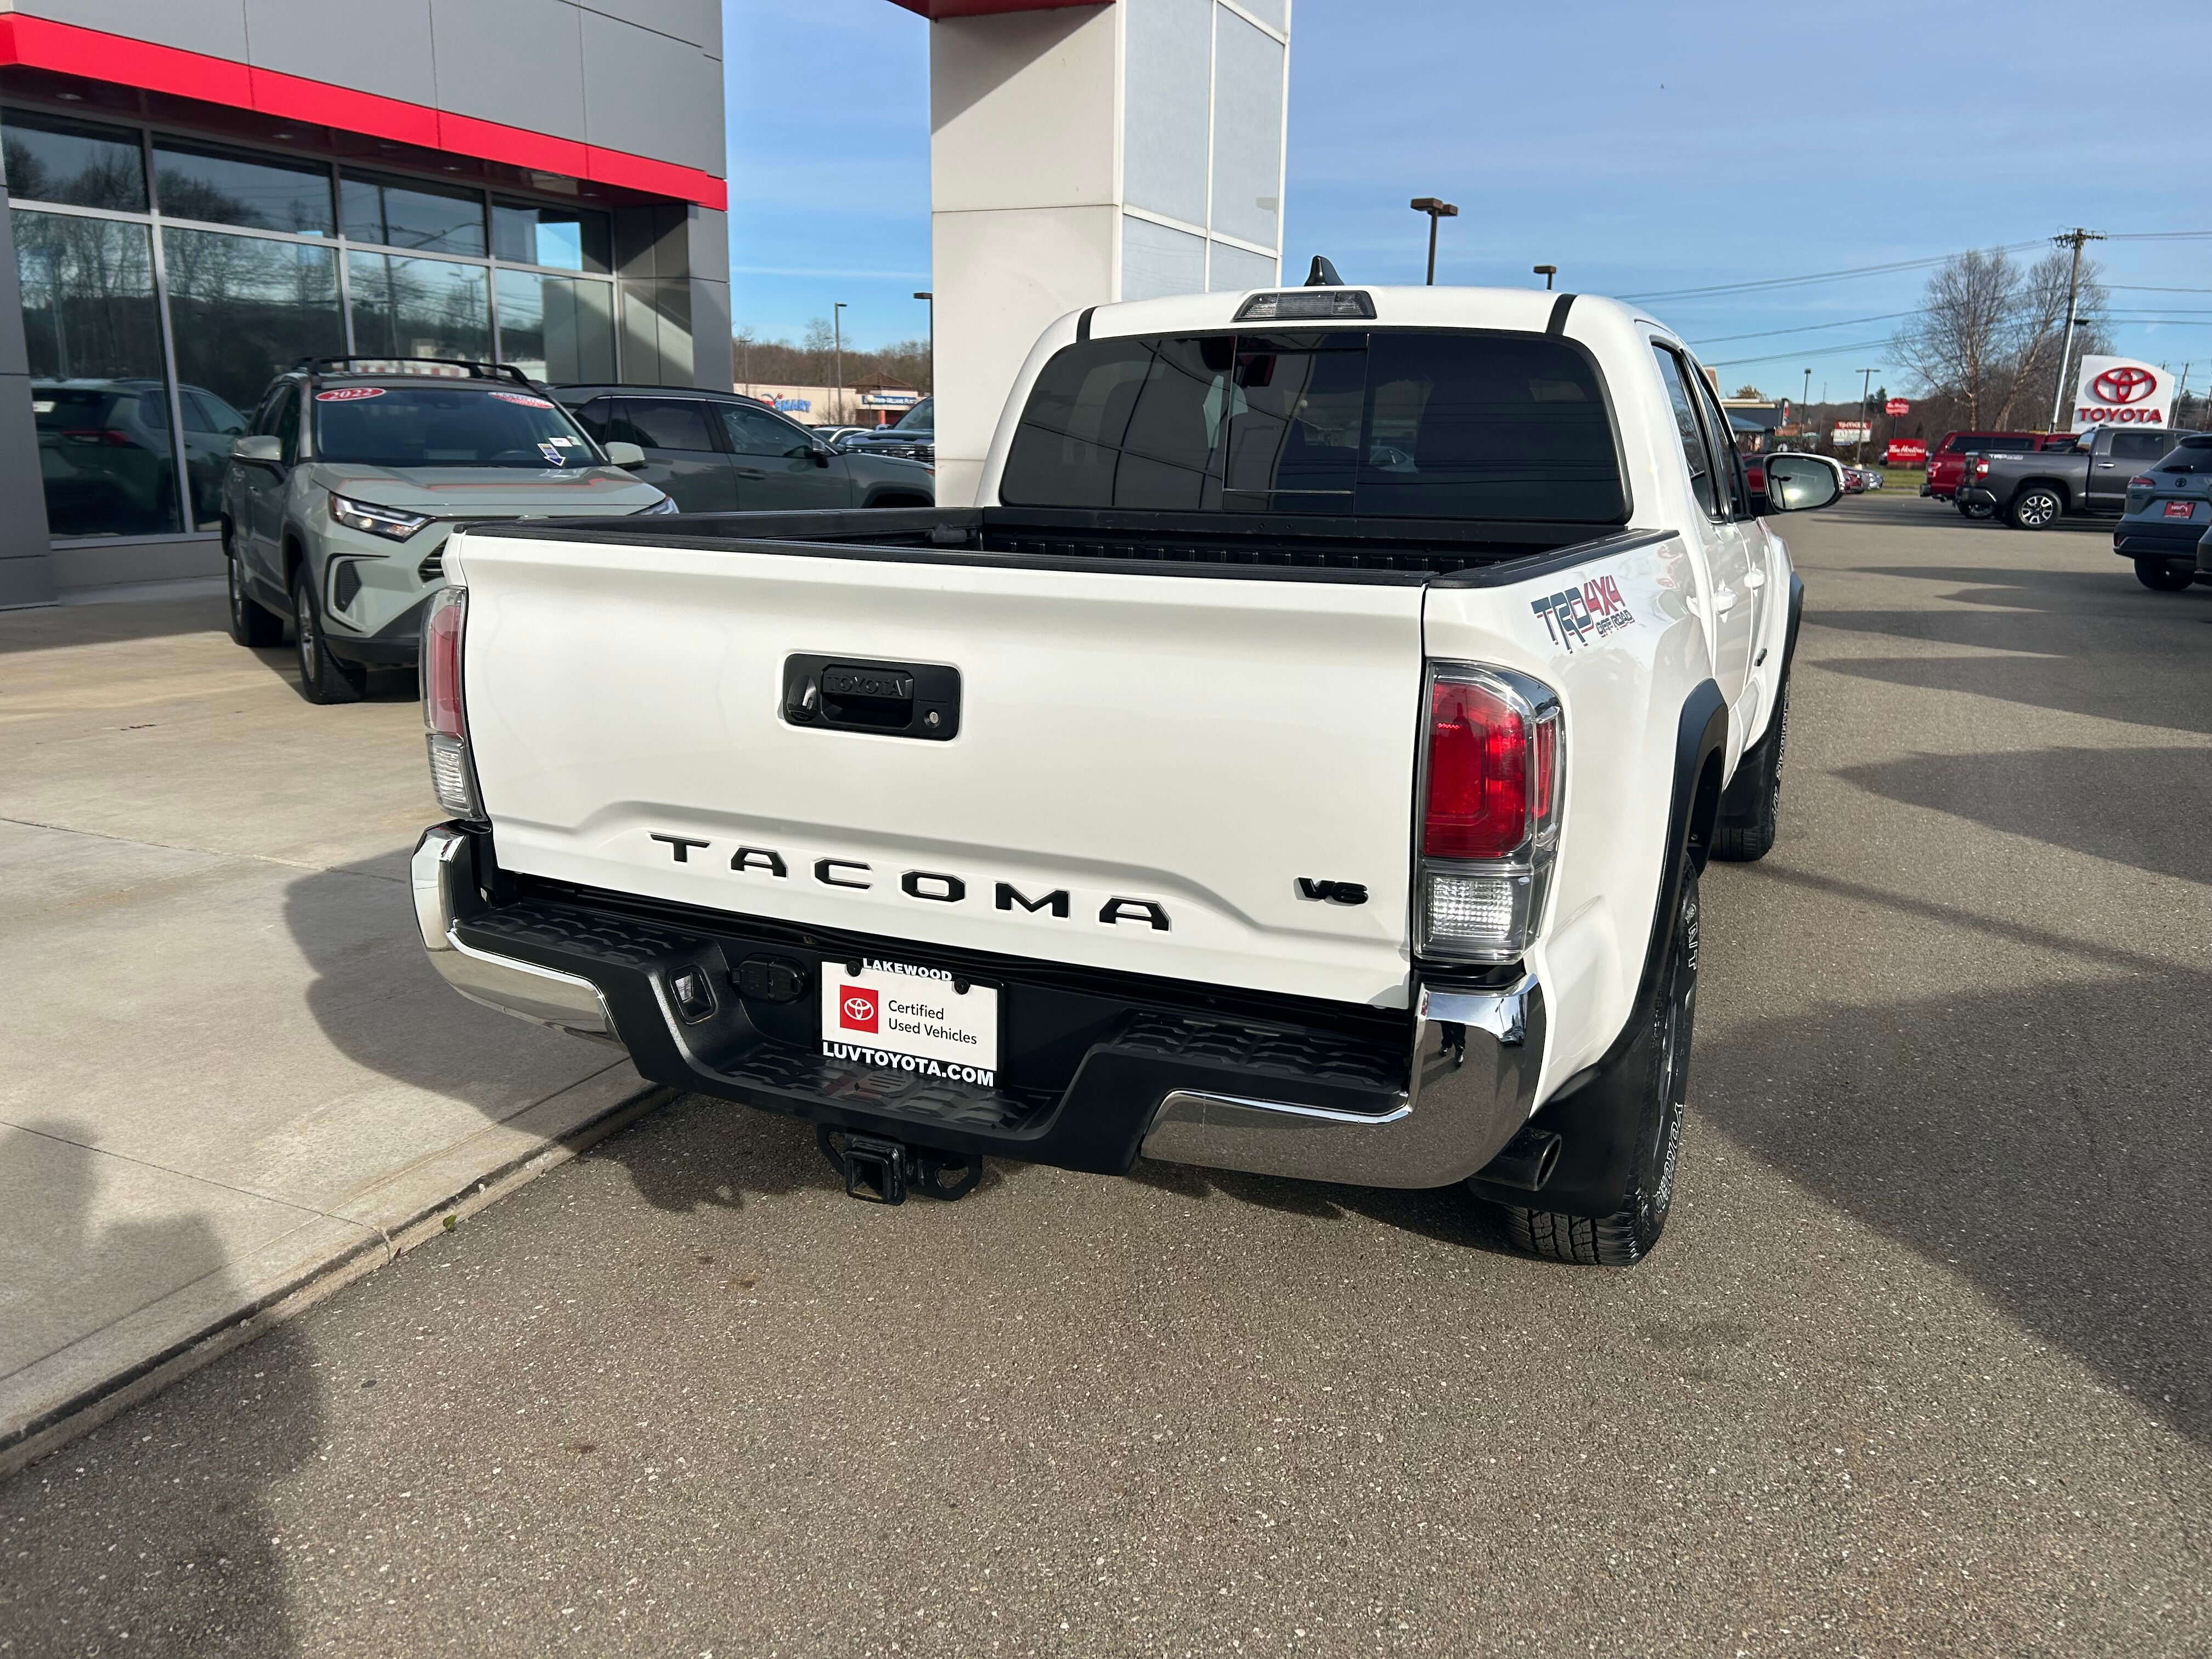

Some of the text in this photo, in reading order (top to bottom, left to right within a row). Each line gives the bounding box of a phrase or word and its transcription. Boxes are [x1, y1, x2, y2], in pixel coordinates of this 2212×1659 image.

[329, 388, 372, 399] 2022
[2078, 407, 2162, 422] TOYOTA
[1531, 587, 1594, 654] TRD
[1595, 610, 1635, 637] OFF ROAD
[827, 674, 904, 697] TOYOTA
[650, 833, 1172, 933] TACOMA
[1297, 877, 1368, 905] V6
[862, 958, 952, 981] LAKEWOOD
[888, 1000, 944, 1020] Certified
[889, 1018, 977, 1045] Used Vehicles
[823, 1041, 994, 1087] LUVTOYOTA.COM
